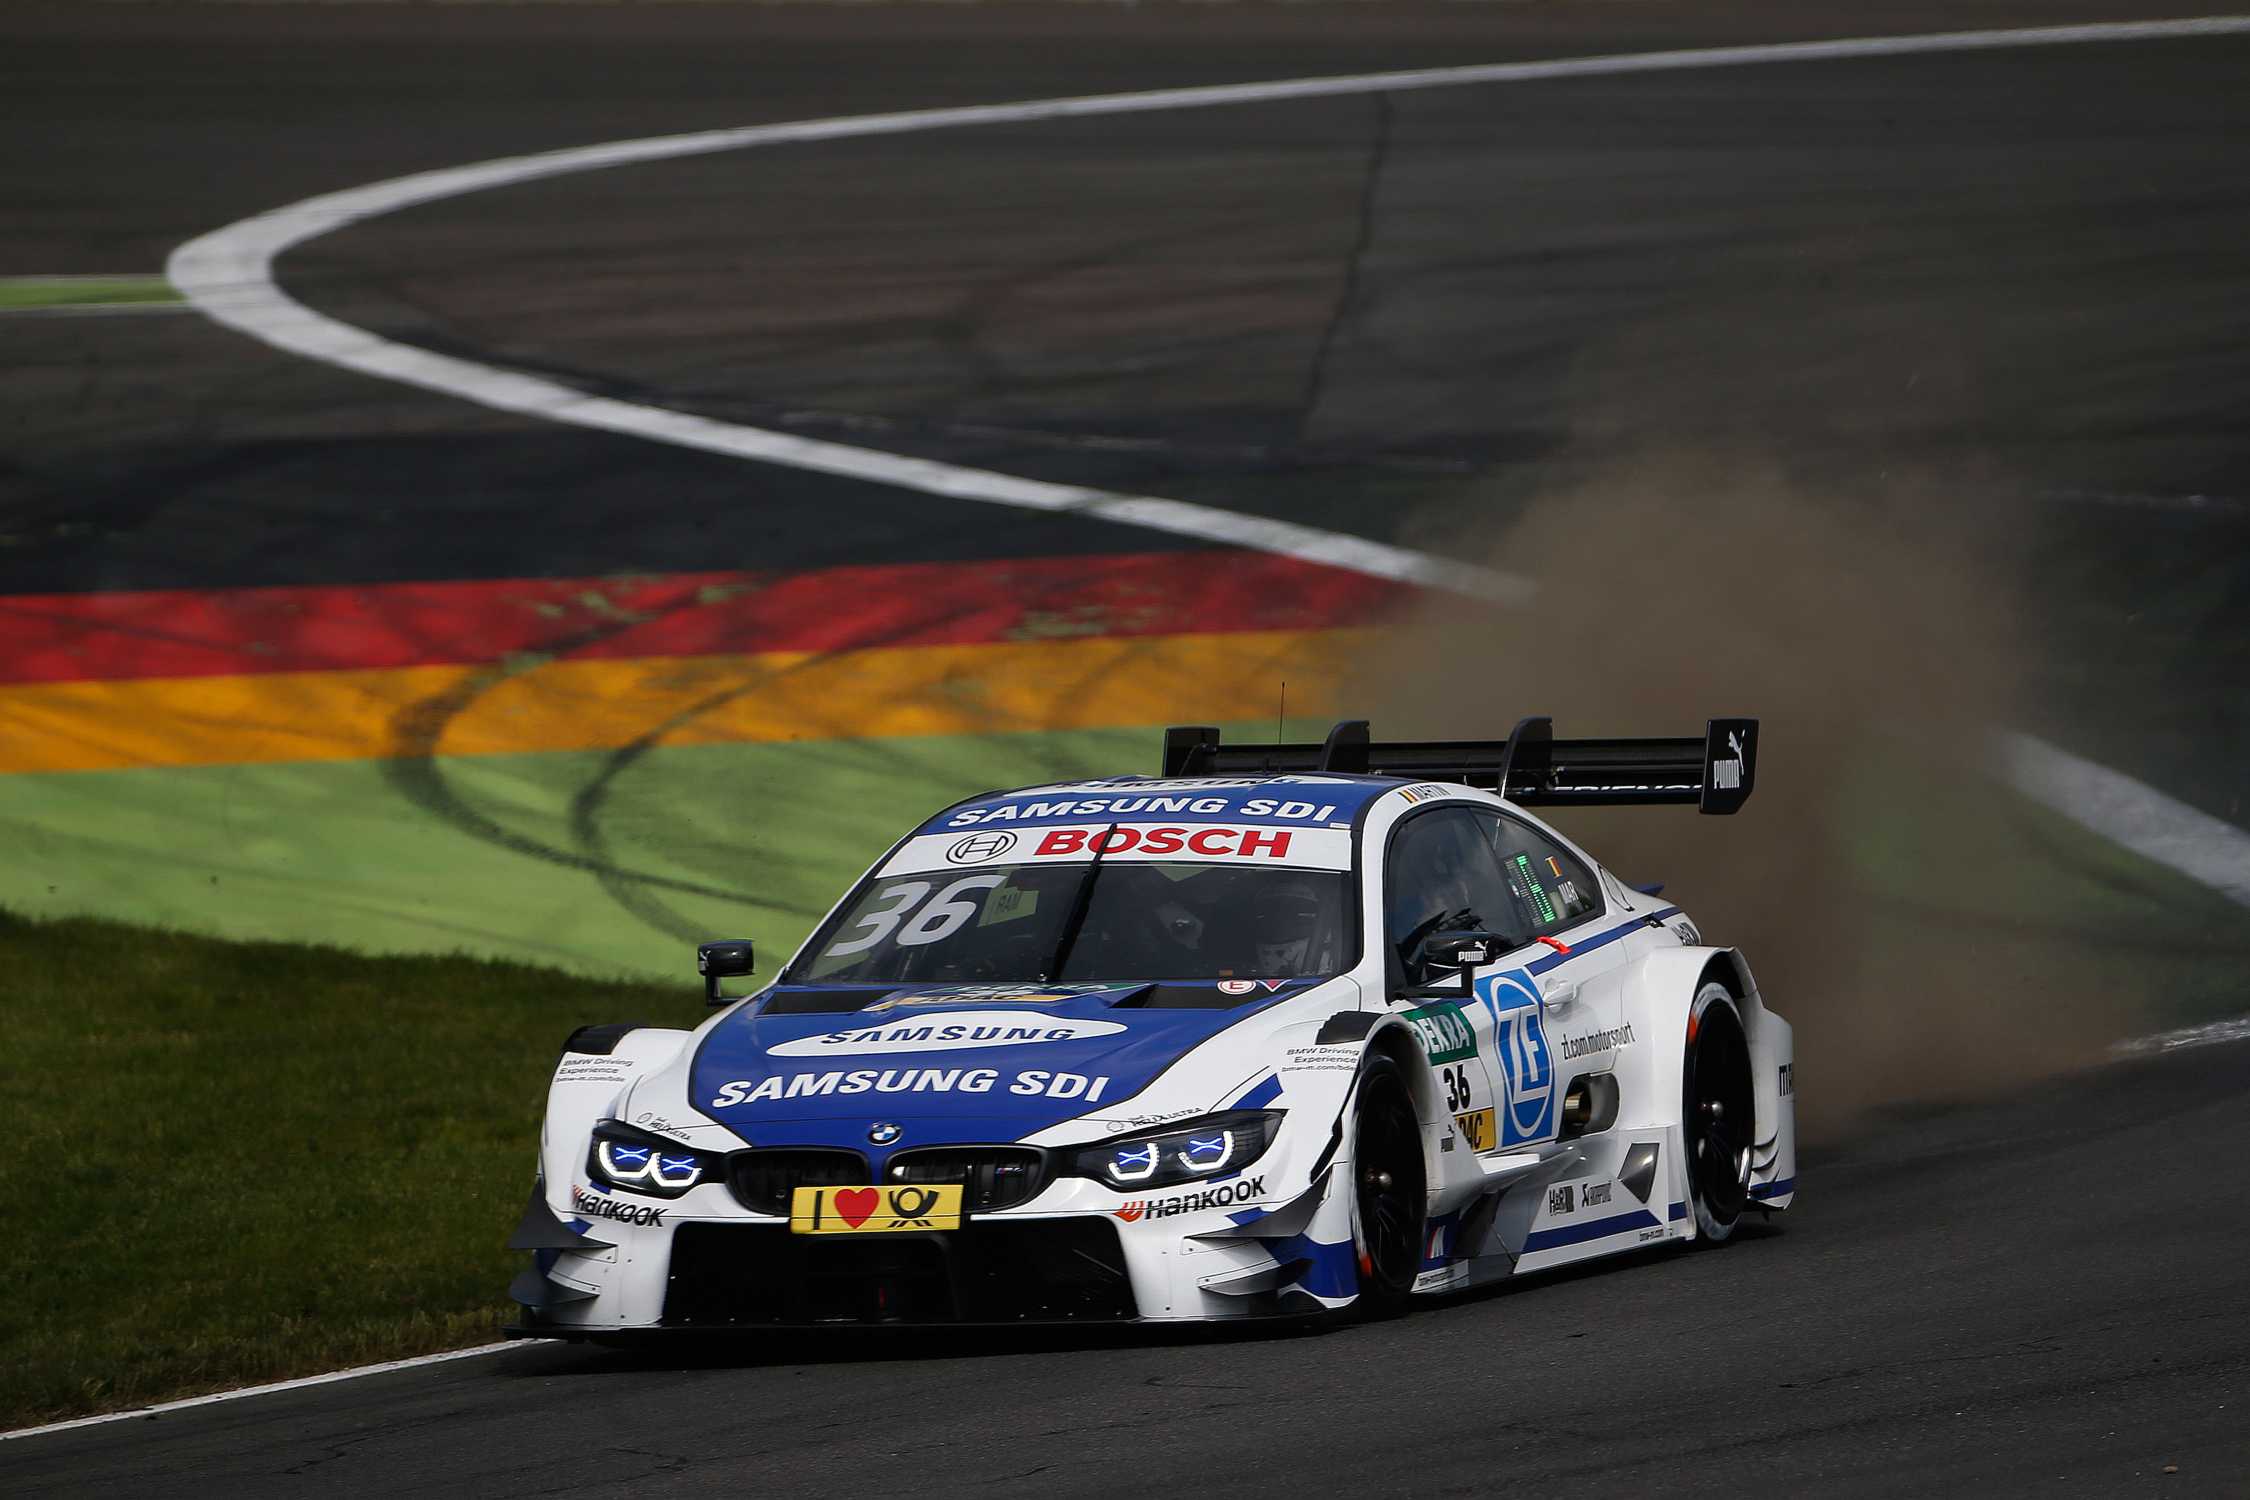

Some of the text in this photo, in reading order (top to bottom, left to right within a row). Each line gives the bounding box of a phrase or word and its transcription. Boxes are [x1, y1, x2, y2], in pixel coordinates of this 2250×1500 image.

[948, 797, 1336, 828] SAMSUNG SDI
[1033, 827, 1293, 858] BOSCH
[825, 874, 1006, 958] 36
[821, 1026, 1075, 1045] SAMSUNG
[1408, 1012, 1470, 1054] DEKRA
[1498, 1003, 1553, 1105] ZF
[712, 1069, 1110, 1108] SAMSUNG SDI
[1443, 1064, 1471, 1112] 36
[1457, 1112, 1484, 1151] DAC
